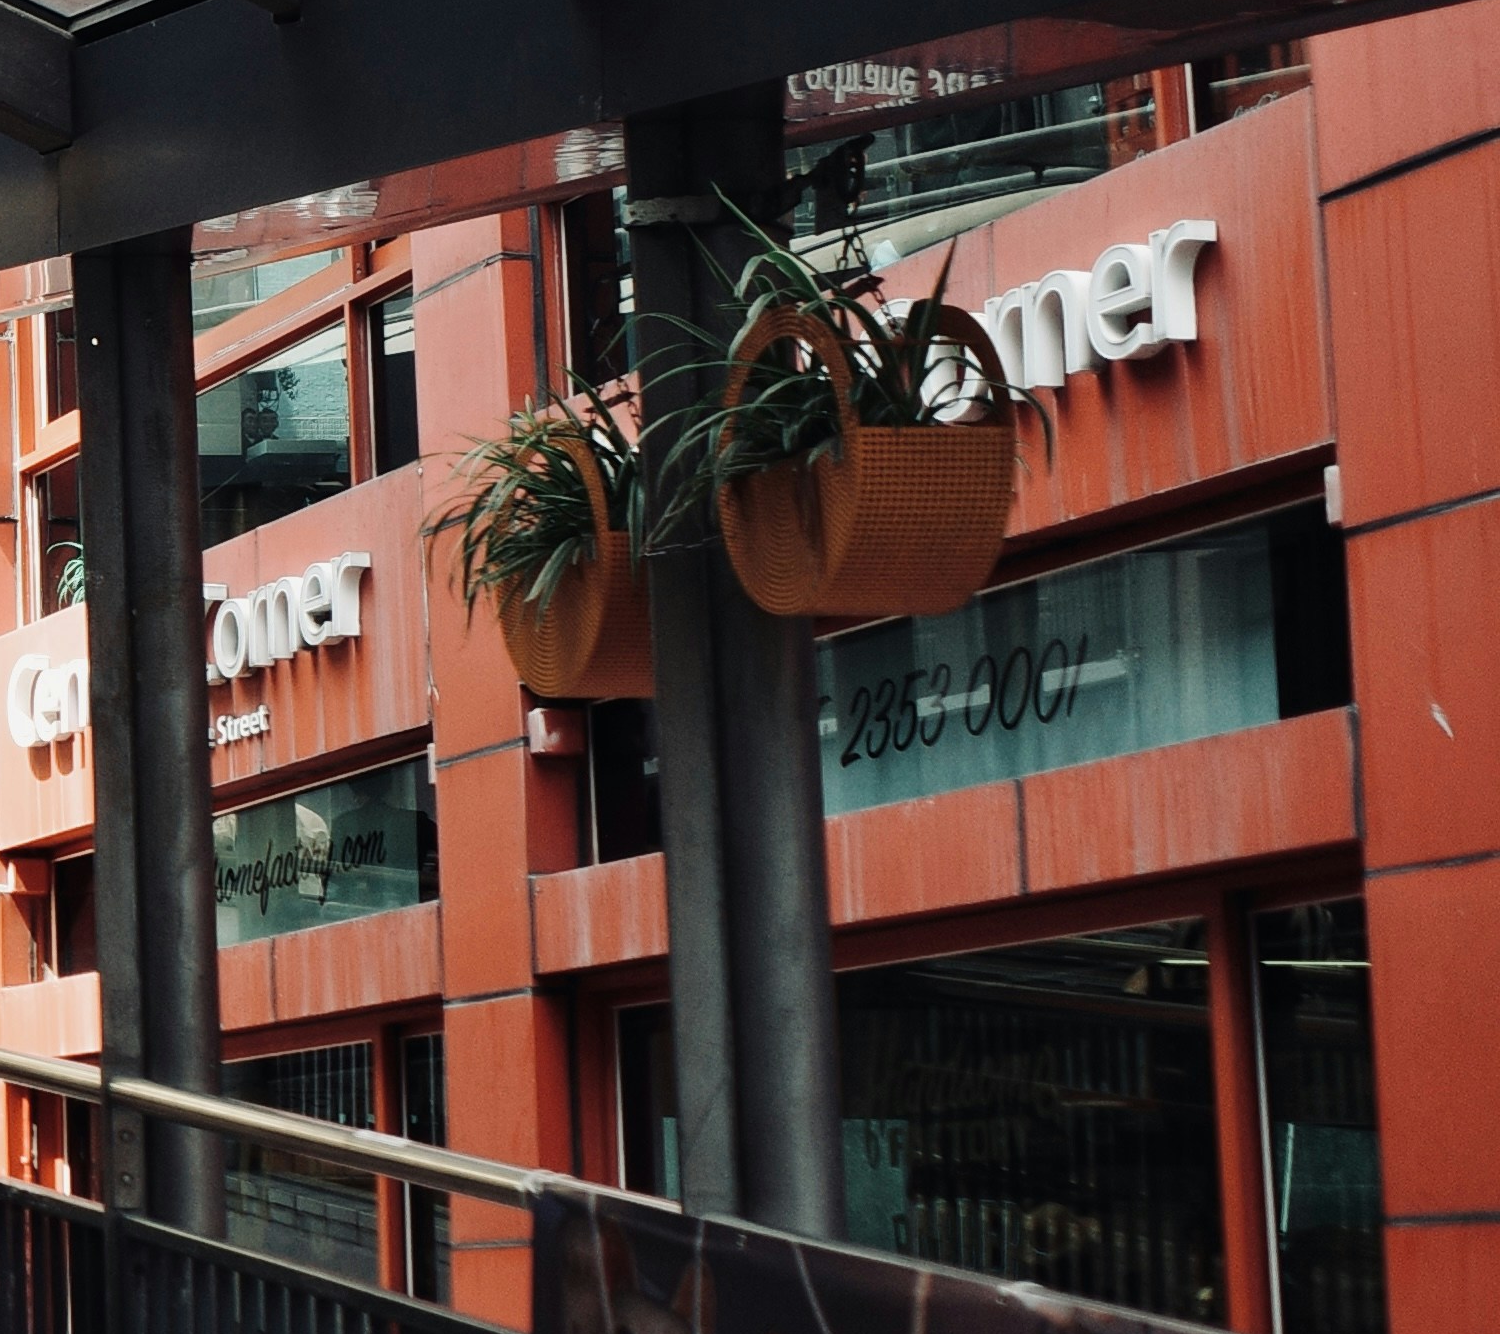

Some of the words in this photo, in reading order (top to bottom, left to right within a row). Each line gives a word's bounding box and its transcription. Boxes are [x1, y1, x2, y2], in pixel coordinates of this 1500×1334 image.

[216, 704, 271, 745] Street
[840, 663, 951, 768] 2353
[965, 633, 1088, 737] 0001
